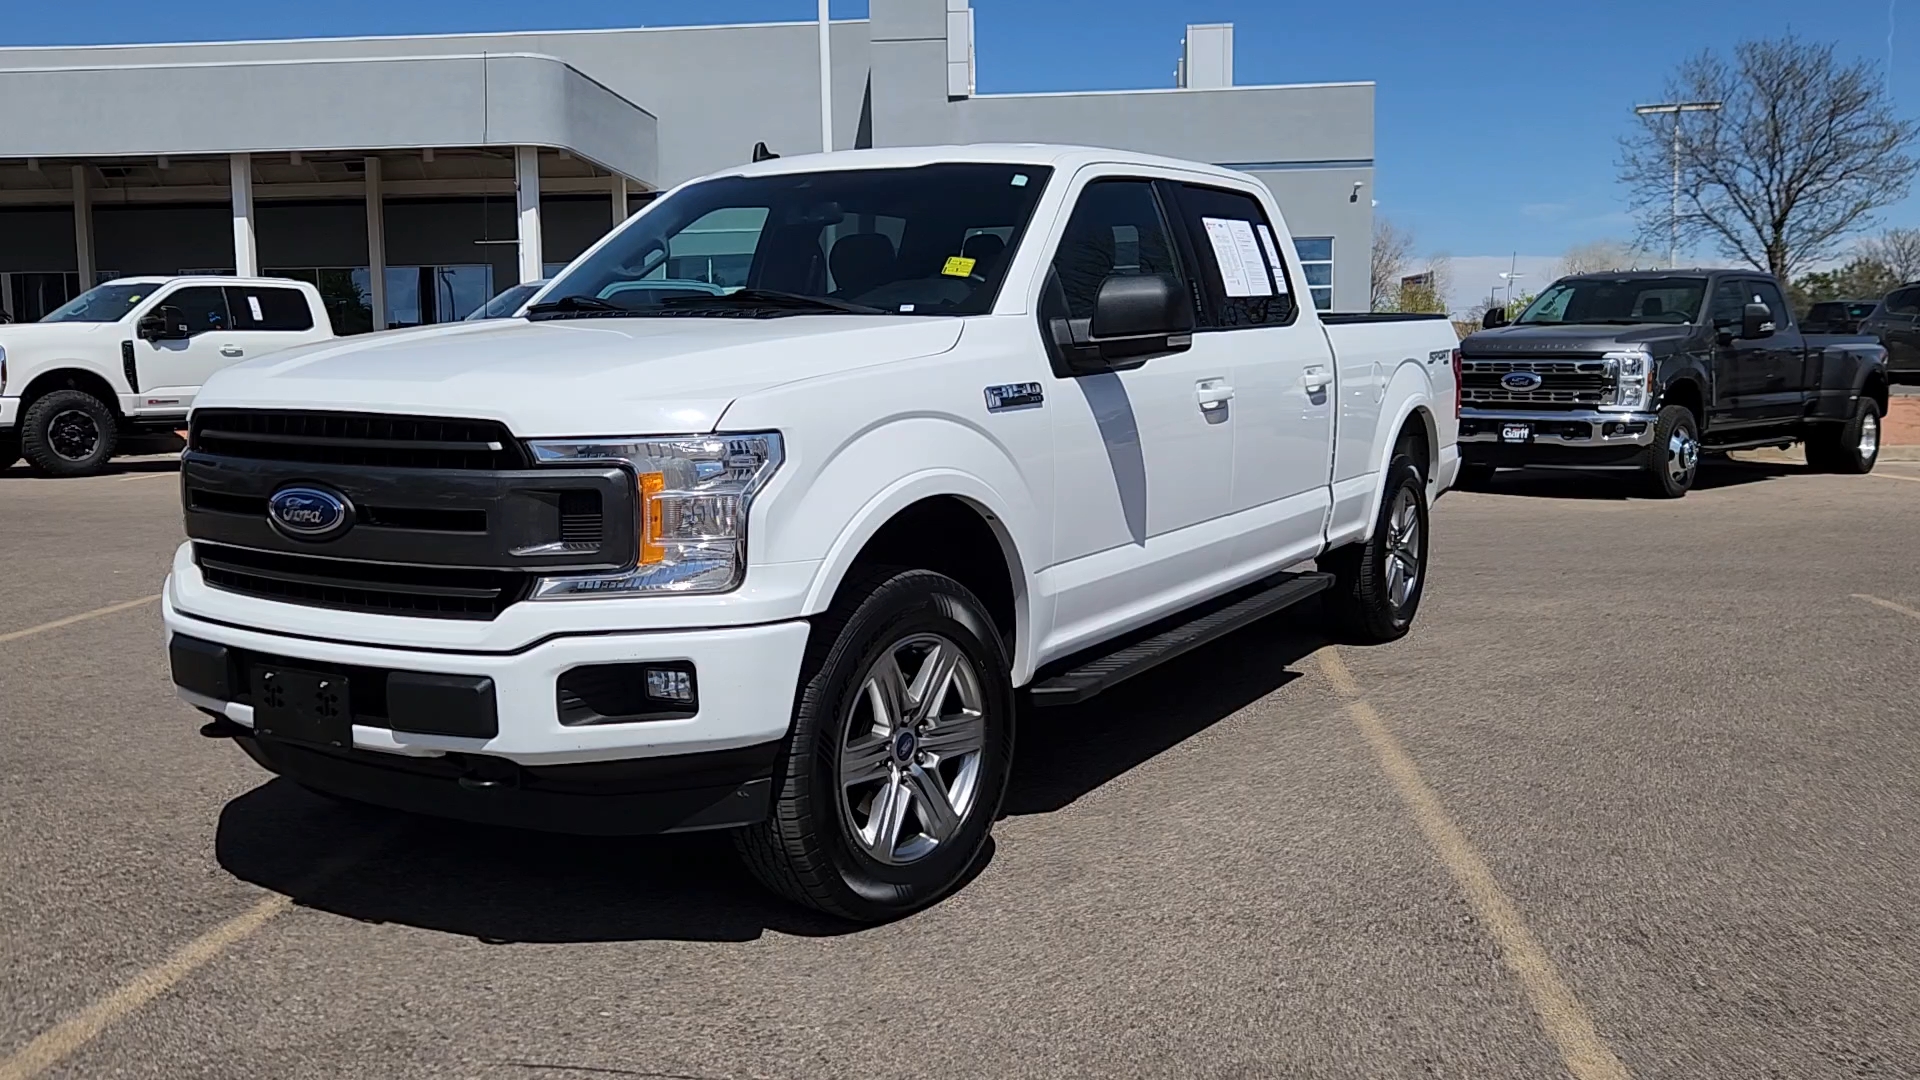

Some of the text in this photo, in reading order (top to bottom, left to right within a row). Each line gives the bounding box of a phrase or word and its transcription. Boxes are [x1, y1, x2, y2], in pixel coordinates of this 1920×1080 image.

[1428, 349, 1450, 365] SPORT
[1510, 377, 1529, 386] Ford
[1503, 427, 1529, 439] Garff
[282, 496, 324, 523] Ford
